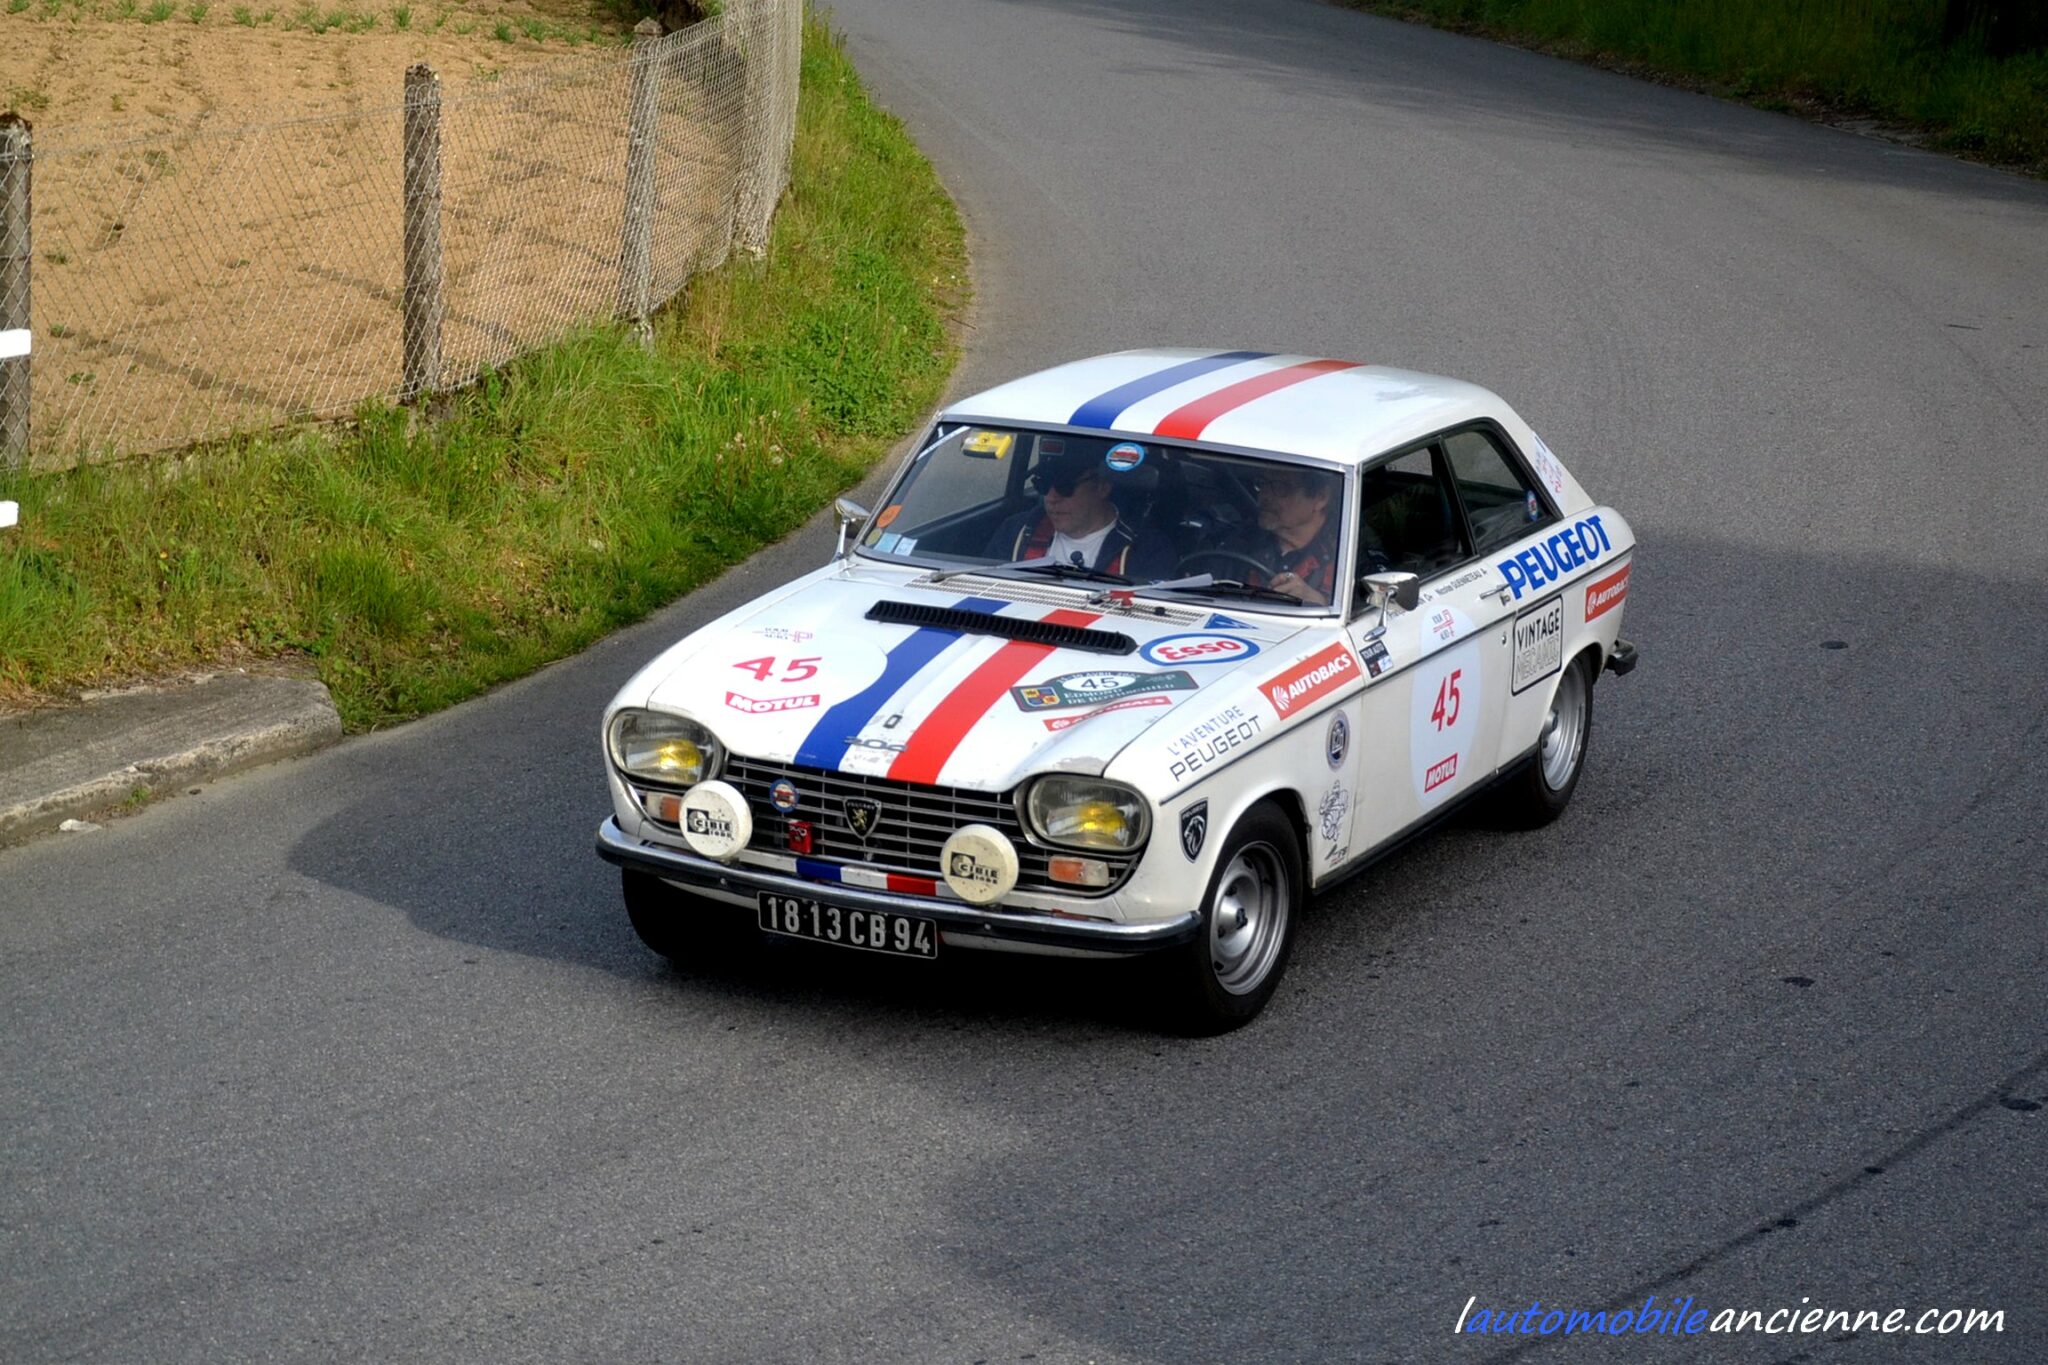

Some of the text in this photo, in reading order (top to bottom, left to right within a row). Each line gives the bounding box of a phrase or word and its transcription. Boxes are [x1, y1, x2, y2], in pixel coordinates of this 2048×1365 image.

[1498, 515, 1611, 599] PEUGEOT
[1517, 607, 1560, 652] VINTAGE
[732, 656, 822, 682] 45
[1081, 677, 1119, 690] 45
[1289, 653, 1352, 699] AUTOBACS
[728, 694, 817, 713] MOTUL
[1431, 669, 1461, 732] 45
[1168, 705, 1245, 757] L'AVENTURE
[1170, 715, 1263, 782] PEUGEOT
[1427, 759, 1457, 789] MOTUL
